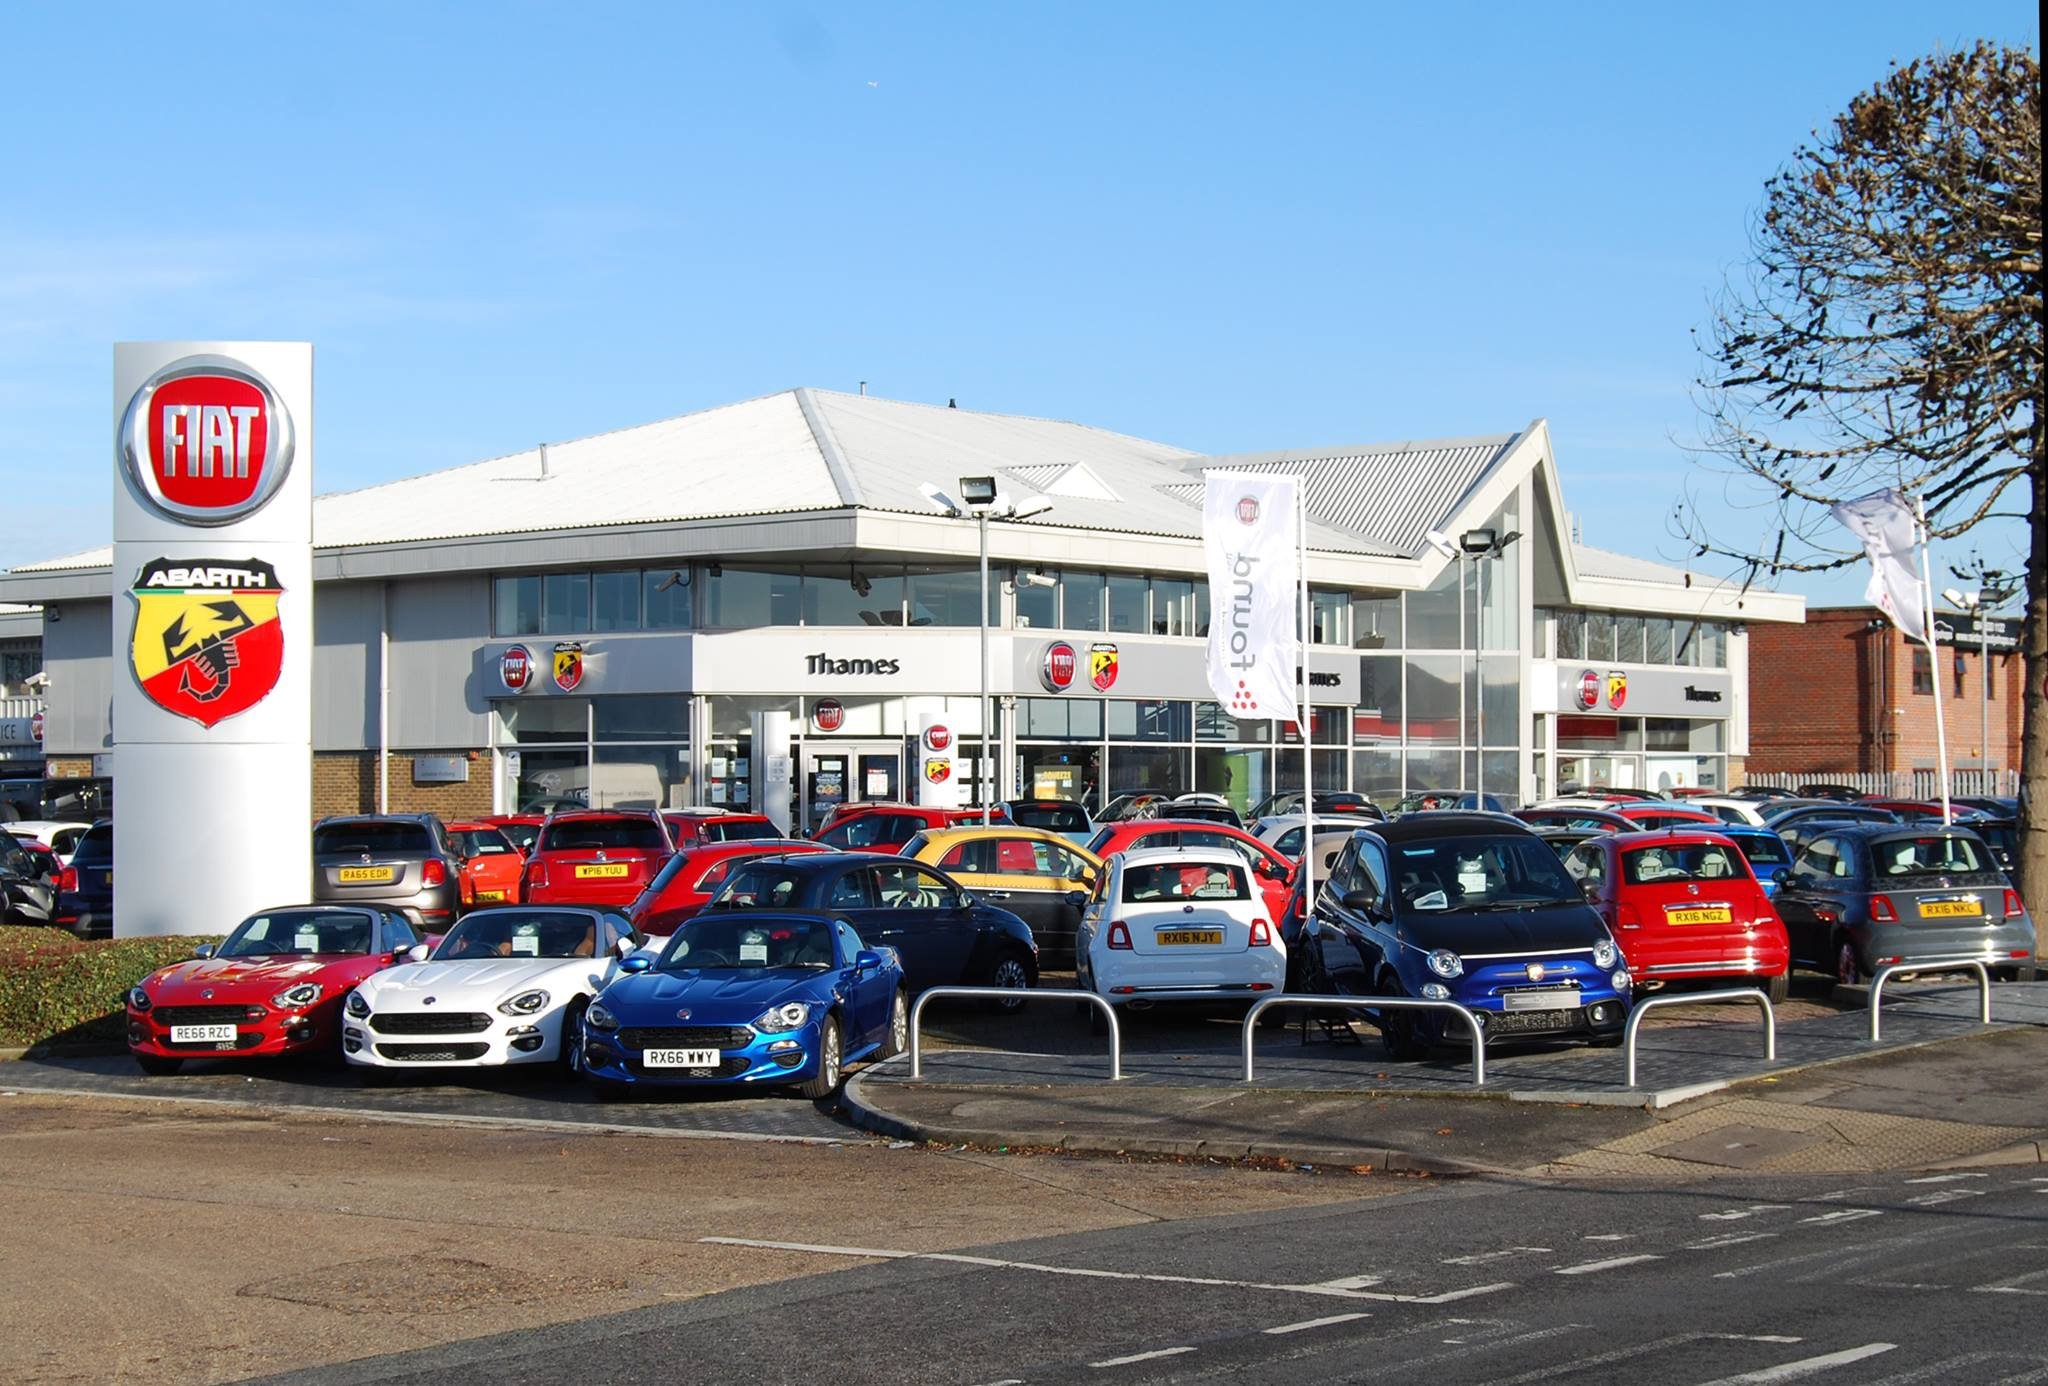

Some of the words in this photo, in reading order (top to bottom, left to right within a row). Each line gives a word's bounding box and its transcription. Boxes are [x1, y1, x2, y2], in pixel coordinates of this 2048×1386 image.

[163, 405, 260, 478] FIAT
[147, 568, 266, 588] ABARTH
[804, 652, 900, 675] Thames
[343, 870, 368, 879] RA65
[1675, 912, 1700, 922] RX16
[1164, 932, 1190, 943] RX16
[1192, 932, 1214, 943] NJY
[177, 1028, 206, 1039] RE66
[208, 1027, 231, 1038] RZC
[650, 1051, 684, 1064] RX66
[688, 1051, 713, 1064] WWY
